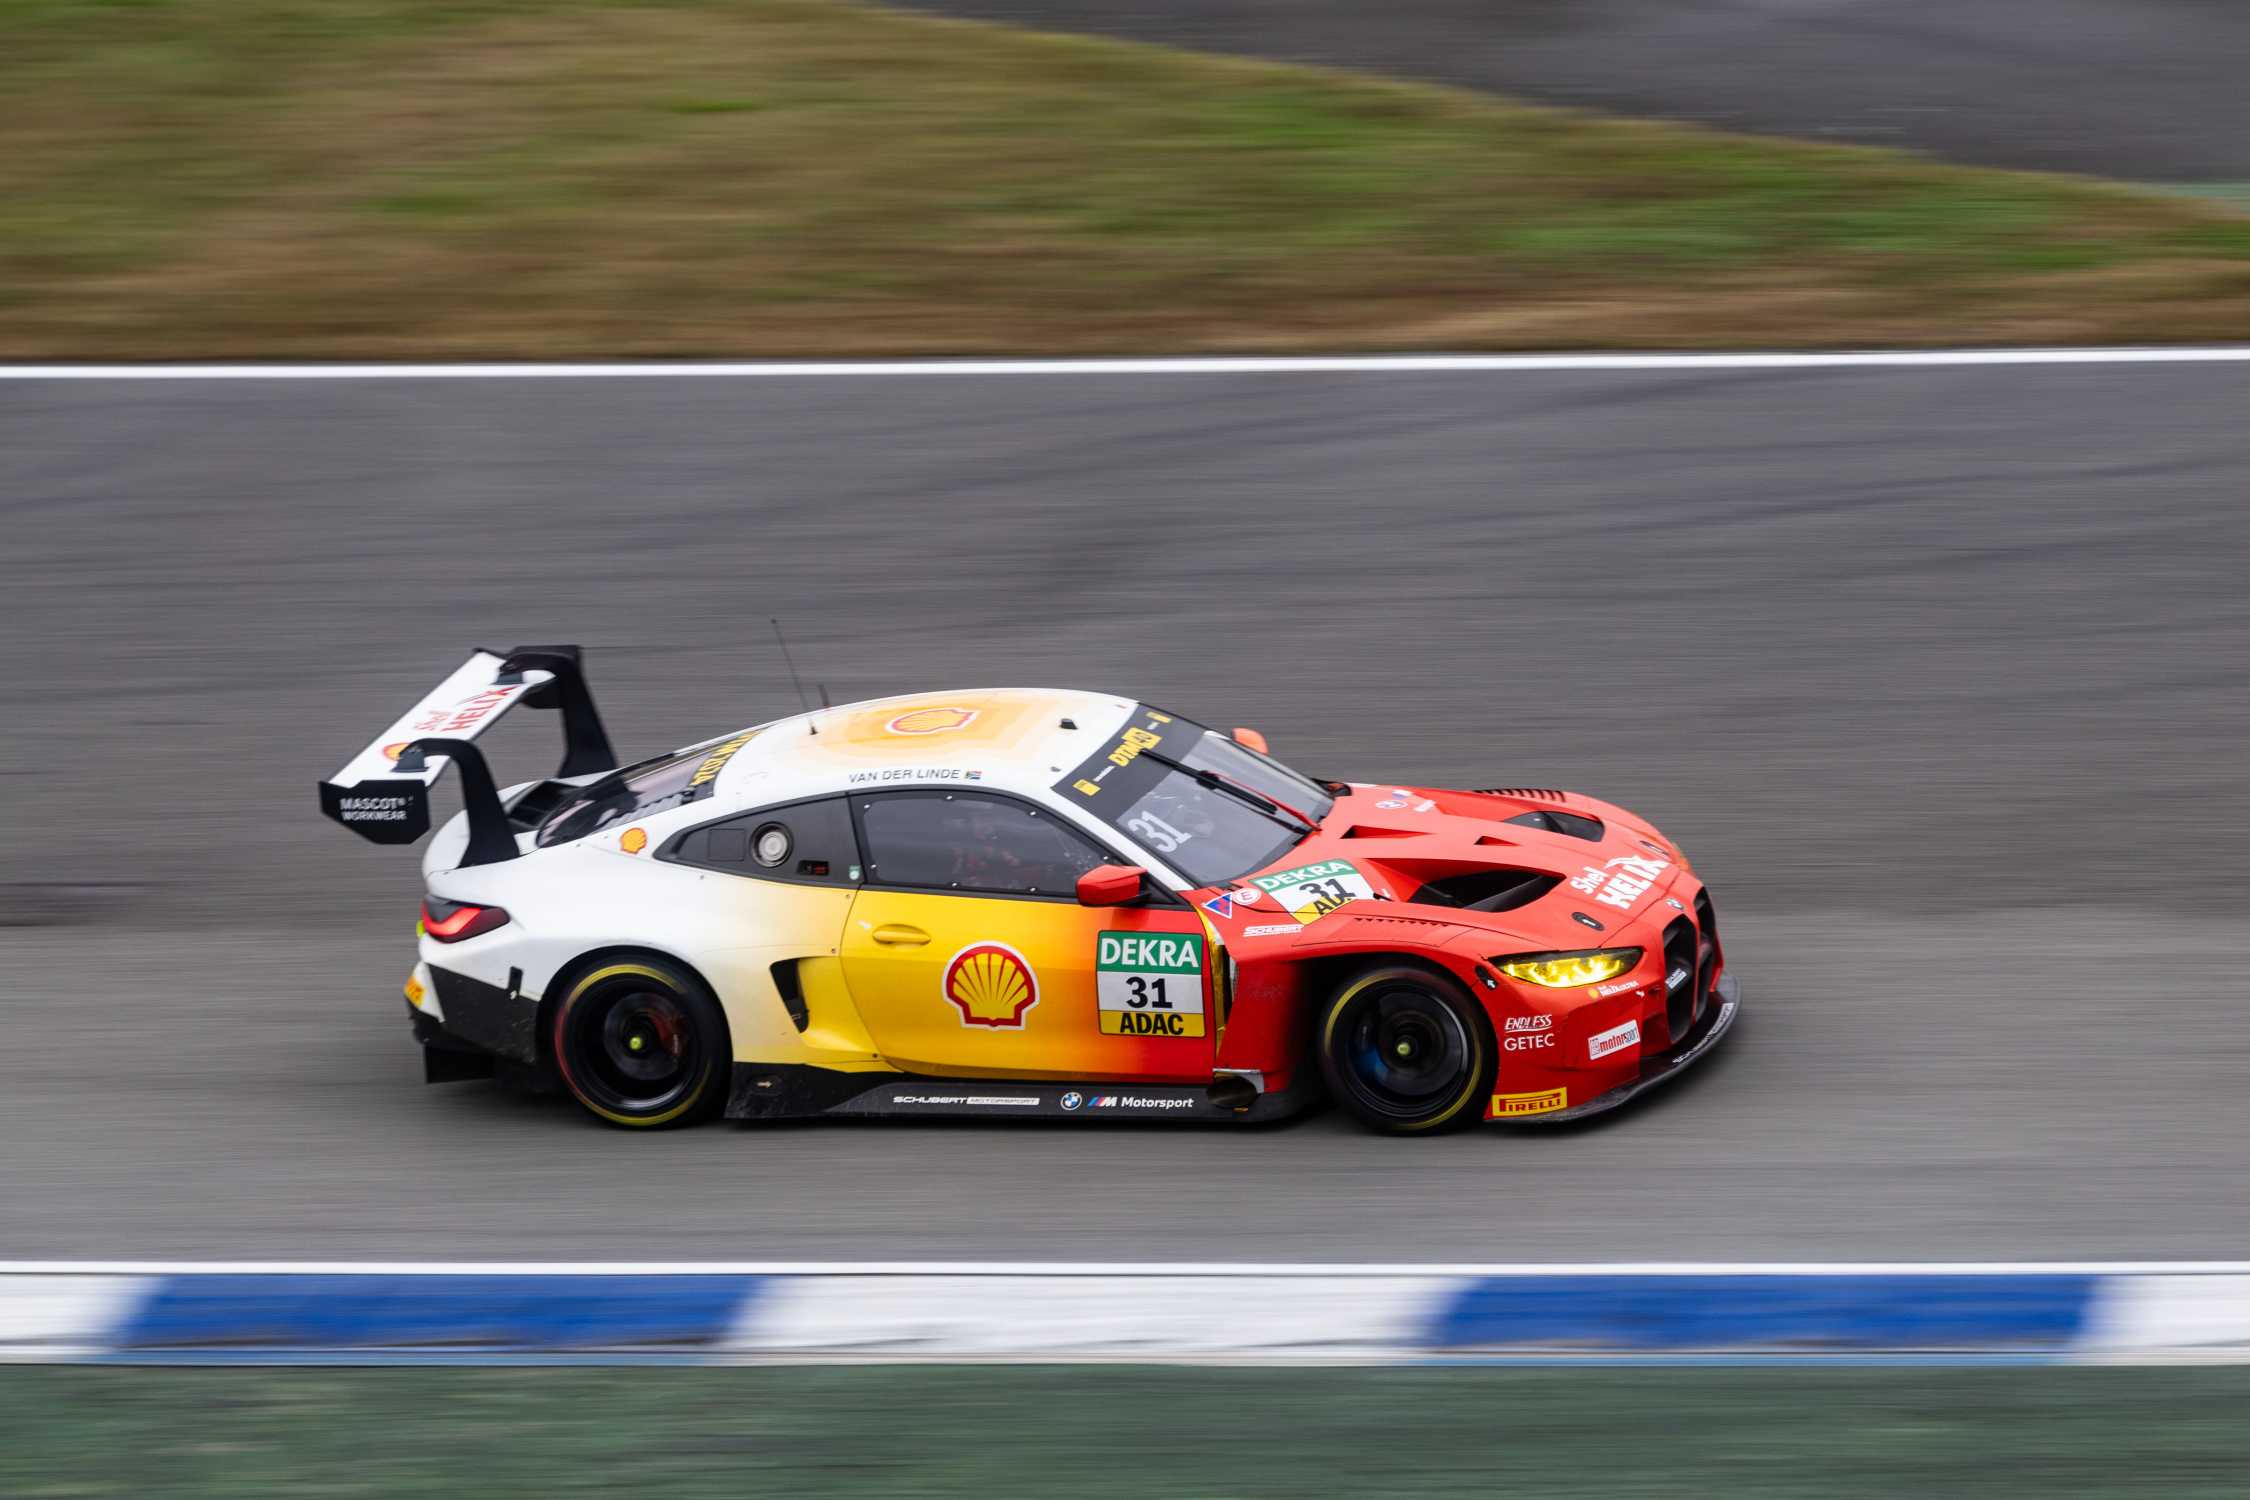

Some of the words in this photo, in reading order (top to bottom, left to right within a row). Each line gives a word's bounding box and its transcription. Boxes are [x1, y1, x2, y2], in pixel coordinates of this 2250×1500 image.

[849, 773, 877, 783] VAN
[882, 770, 912, 780] DER
[917, 769, 960, 779] LINDE
[1128, 811, 1192, 852] 31
[1255, 861, 1353, 890] DEKRA
[1595, 855, 1670, 909] HELIX
[1299, 878, 1357, 902] 31
[1100, 937, 1200, 968] DEKRA
[1126, 976, 1173, 1009] 31
[1119, 1012, 1185, 1036] ADAC
[1504, 1014, 1552, 1031] ENDLESS
[1504, 1033, 1555, 1051] GETEC
[893, 1096, 967, 1105] SCHUBERT
[1121, 1096, 1194, 1110] Motorsport
[1499, 1092, 1562, 1112] PIRELLI
